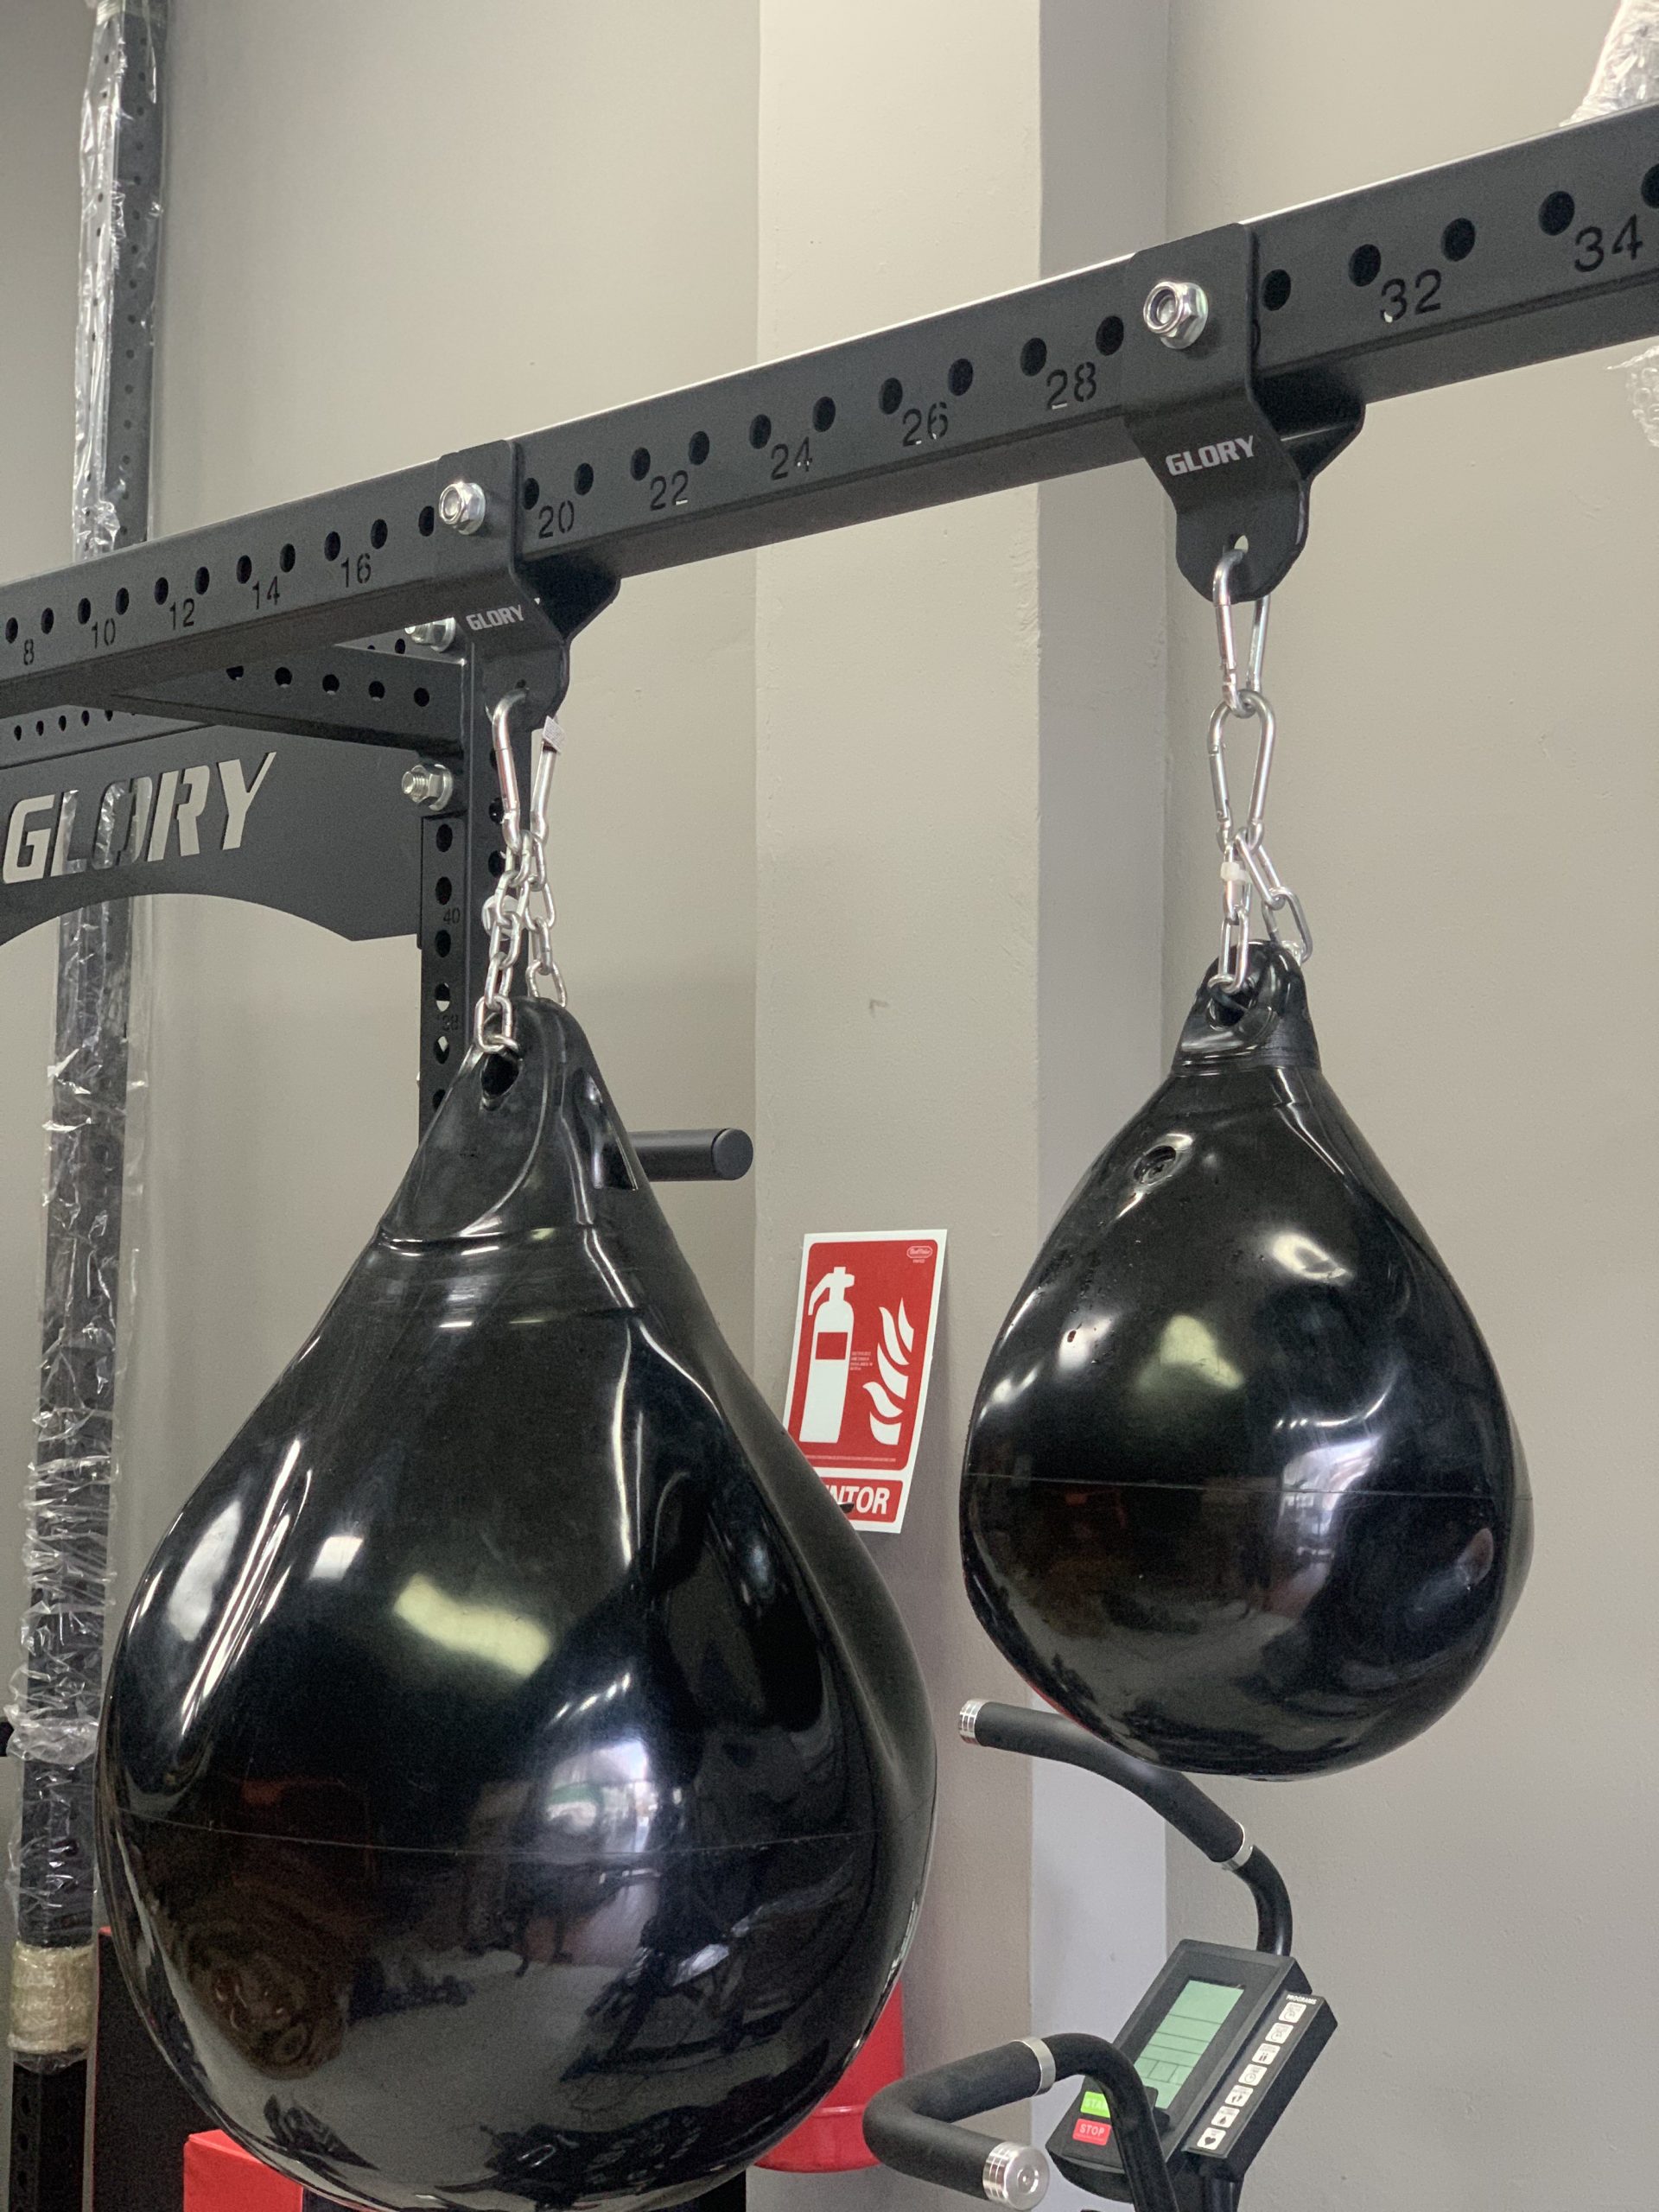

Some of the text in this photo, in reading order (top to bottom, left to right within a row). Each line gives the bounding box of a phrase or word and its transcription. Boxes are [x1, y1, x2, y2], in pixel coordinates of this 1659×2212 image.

[1573, 213, 1643, 272] 34
[1380, 269, 1442, 322] 32
[1046, 361, 1097, 410] 28
[901, 401, 950, 447] 26
[769, 436, 814, 480] 24
[1165, 435, 1255, 476] GLORY
[648, 469, 690, 512] 22
[537, 499, 575, 540] 20
[340, 552, 372, 588] 16
[251, 575, 281, 610] 14
[169, 597, 195, 631] 12
[466, 604, 524, 632] GLORY
[22, 639, 35, 666] 8
[91, 618, 117, 649] 10
[3, 751, 277, 885] GLORY
[442, 907, 461, 925] 40
[825, 1484, 891, 1515] NTOR
[1079, 2123, 1106, 2137] STOP
